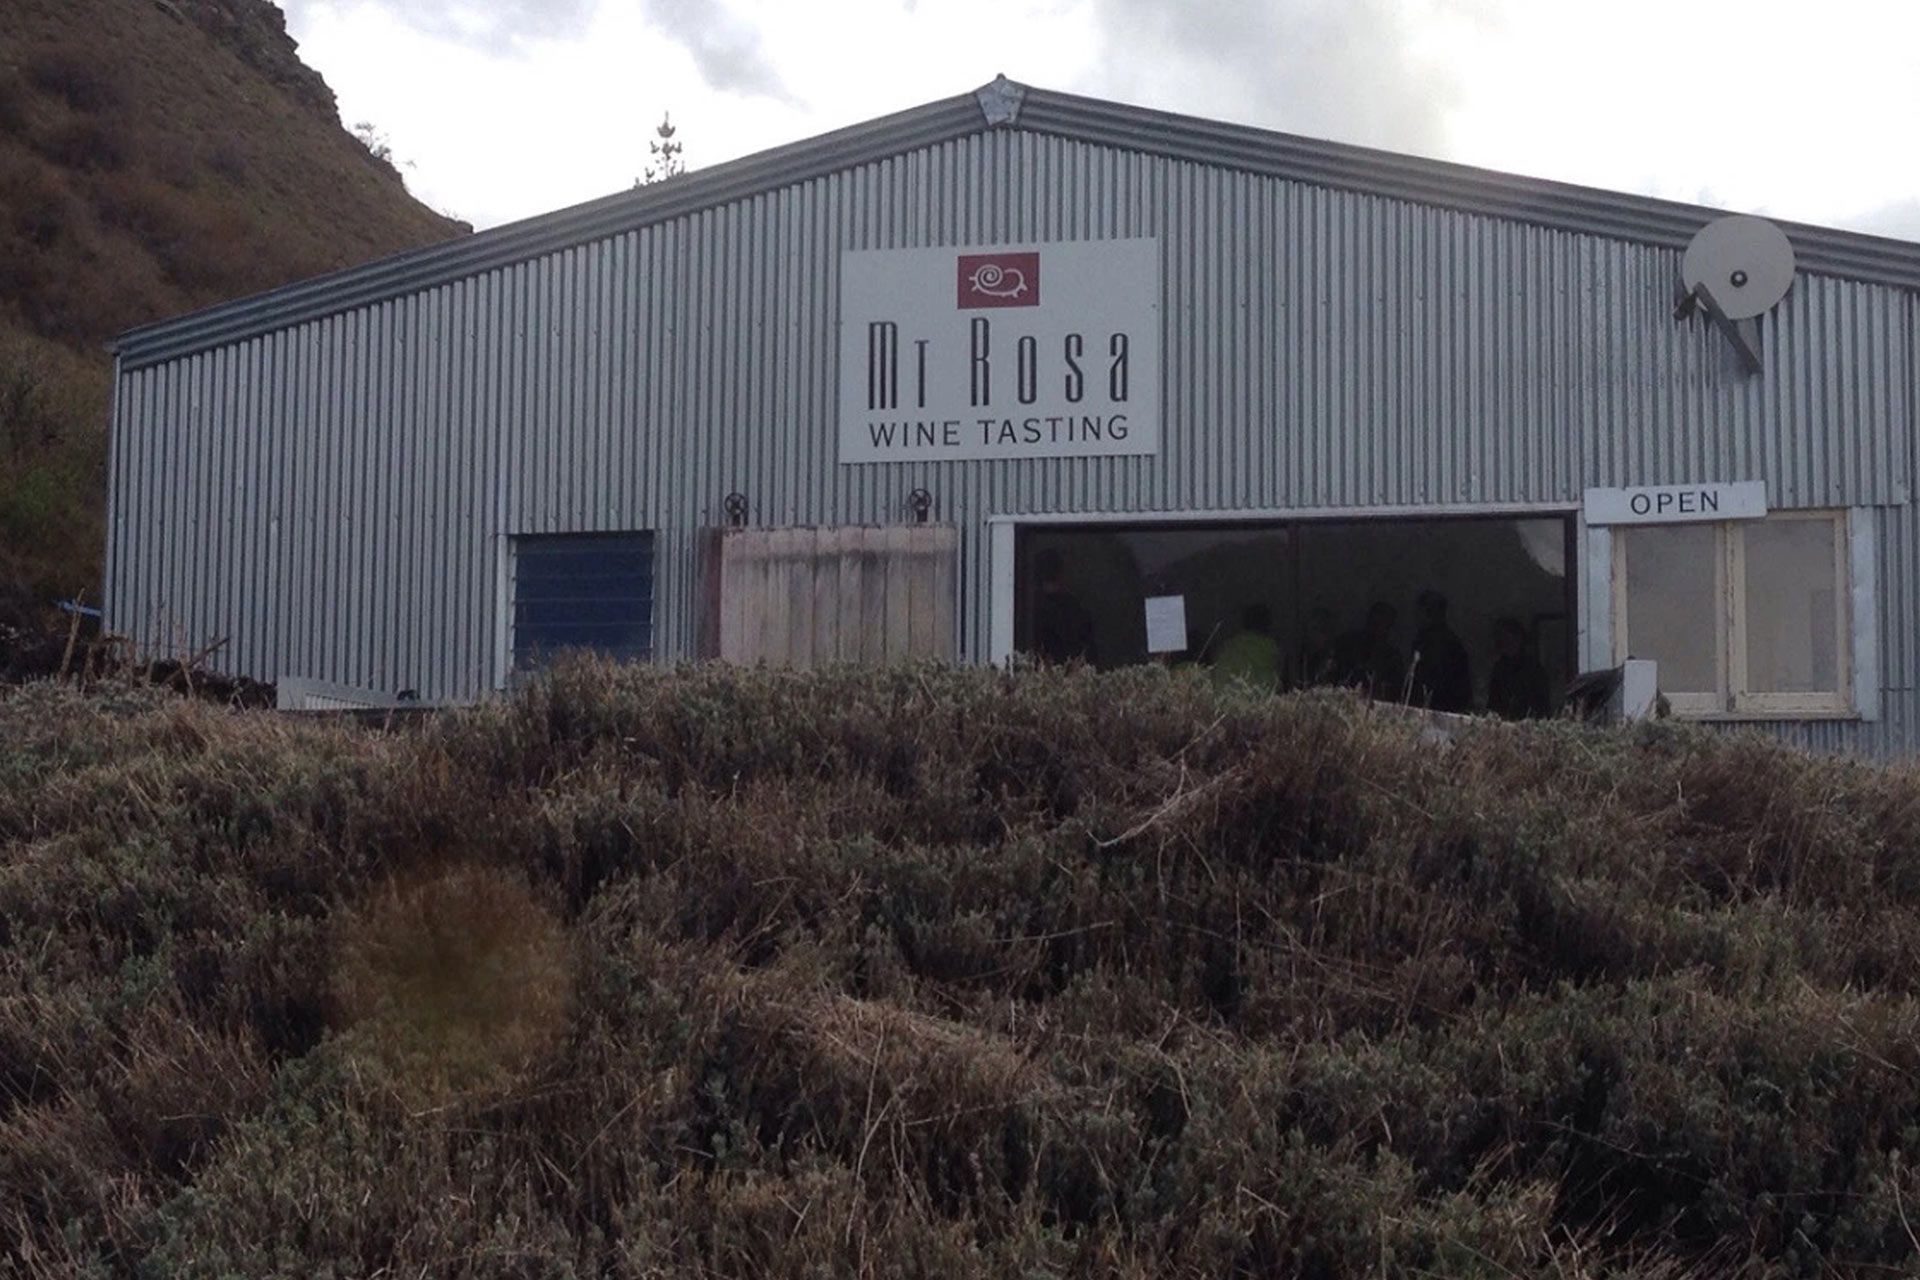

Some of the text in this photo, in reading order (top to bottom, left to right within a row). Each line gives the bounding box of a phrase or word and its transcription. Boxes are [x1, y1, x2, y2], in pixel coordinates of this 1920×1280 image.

[867, 413, 1129, 448] WINE TASTING
[1630, 490, 1719, 515] OPEN
